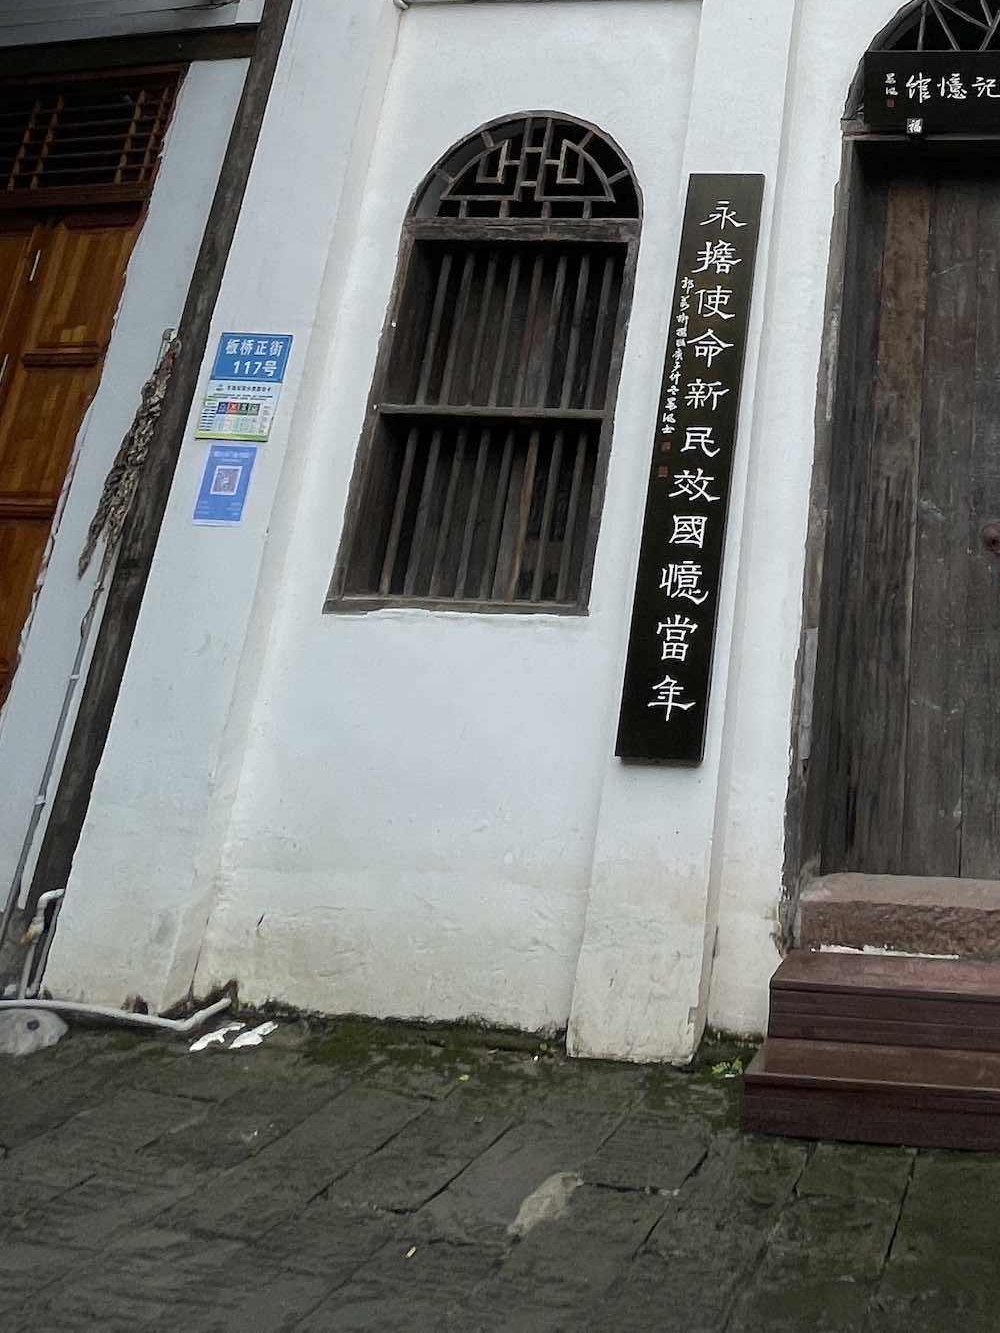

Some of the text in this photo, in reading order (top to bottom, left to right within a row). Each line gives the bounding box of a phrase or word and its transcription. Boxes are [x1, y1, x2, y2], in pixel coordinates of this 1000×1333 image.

[224, 338, 284, 357] 板桥正街
[232, 359, 278, 377] 117号
